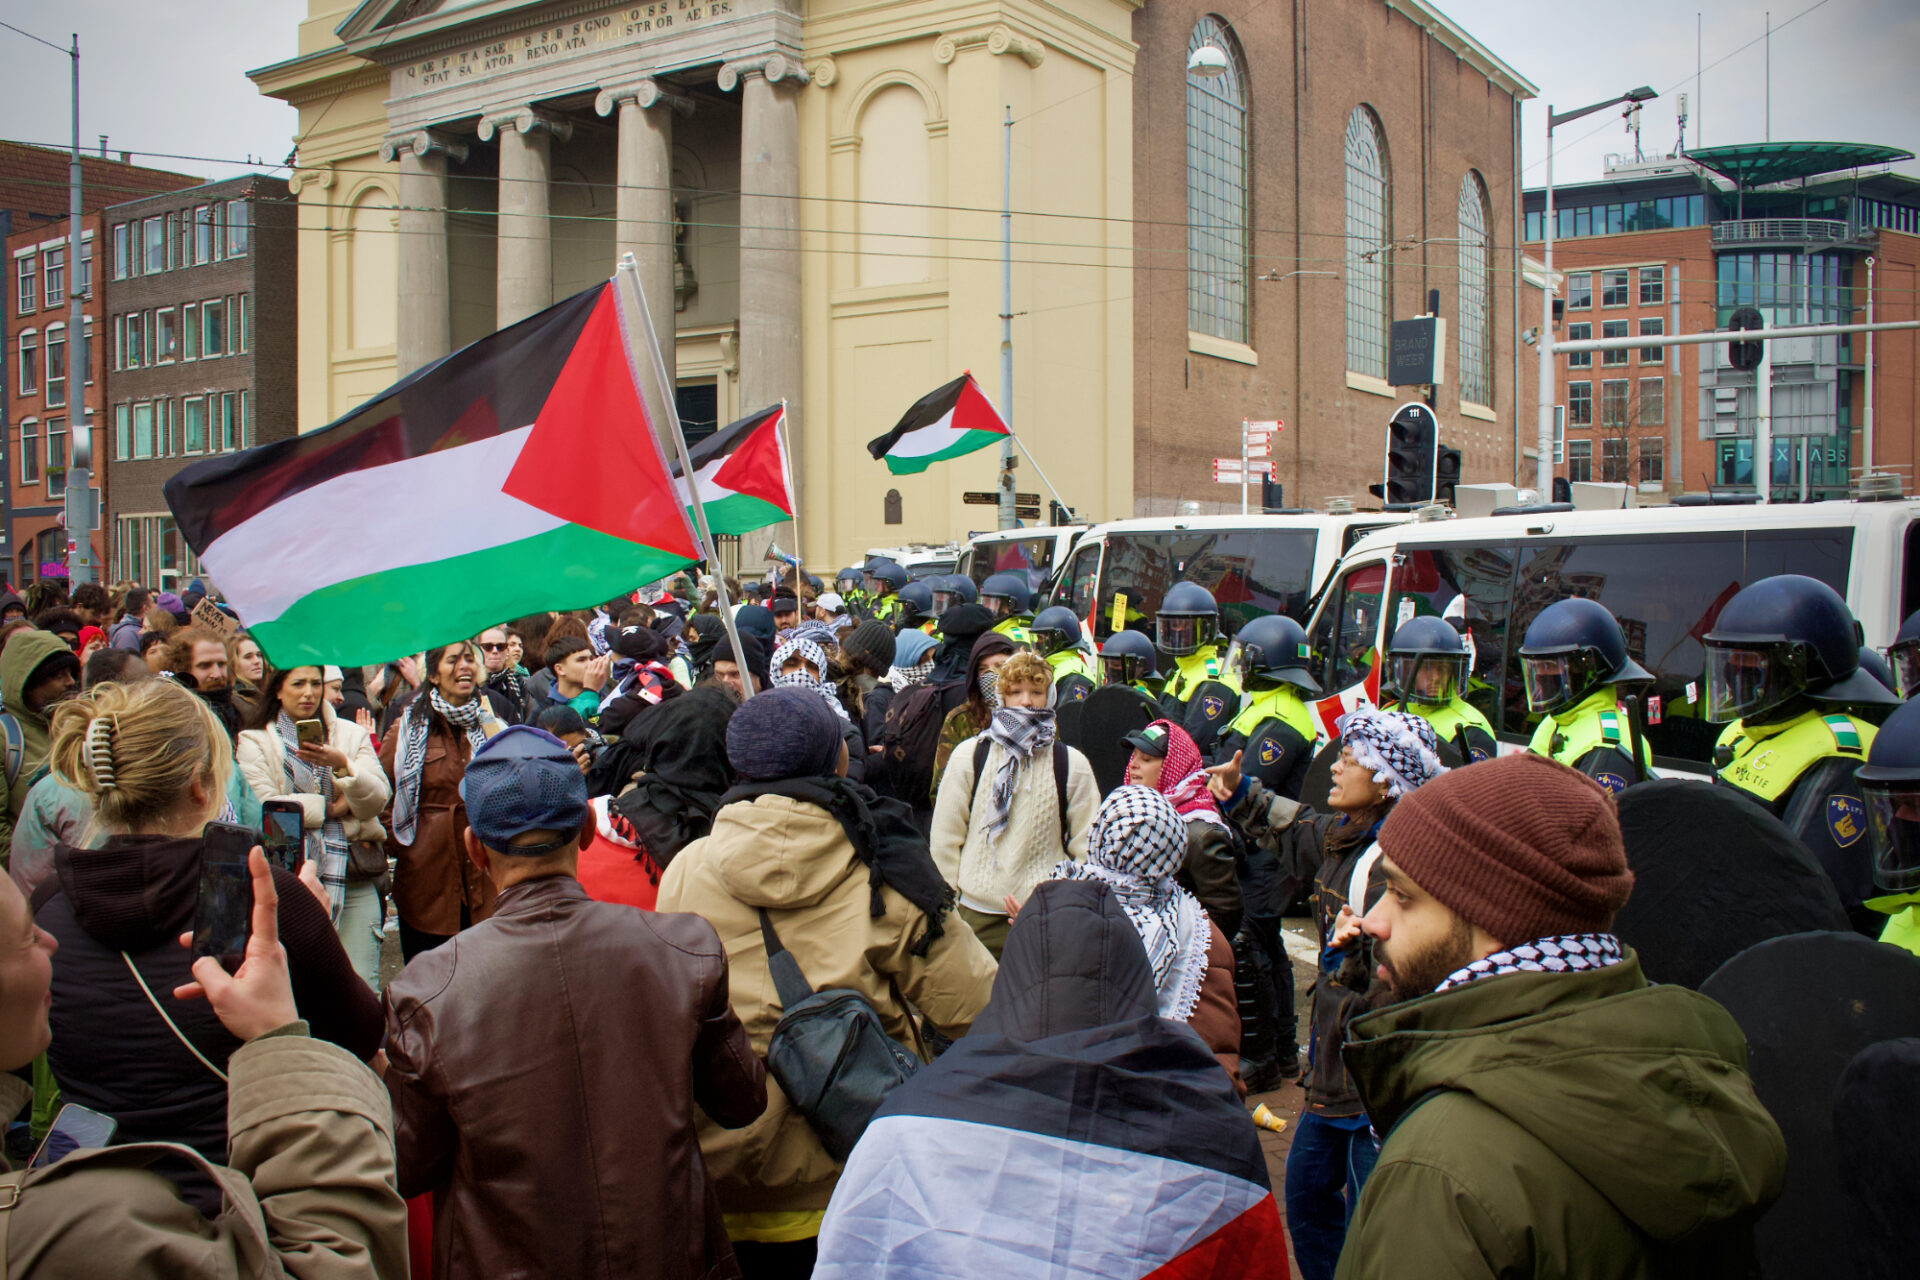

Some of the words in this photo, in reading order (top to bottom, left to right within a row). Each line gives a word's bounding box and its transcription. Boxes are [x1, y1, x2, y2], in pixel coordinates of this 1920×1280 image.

[472, 51, 479, 61] A
[423, 69, 450, 86] STAT
[1394, 336, 1428, 351] BRAND
[1396, 352, 1425, 367] WEER
[1408, 408, 1420, 418] 111
[1724, 448, 1788, 462] FLX
[1796, 448, 1845, 462] LABS
[201, 601, 224, 626] NEVER
[1735, 766, 1769, 788] POLTIE
